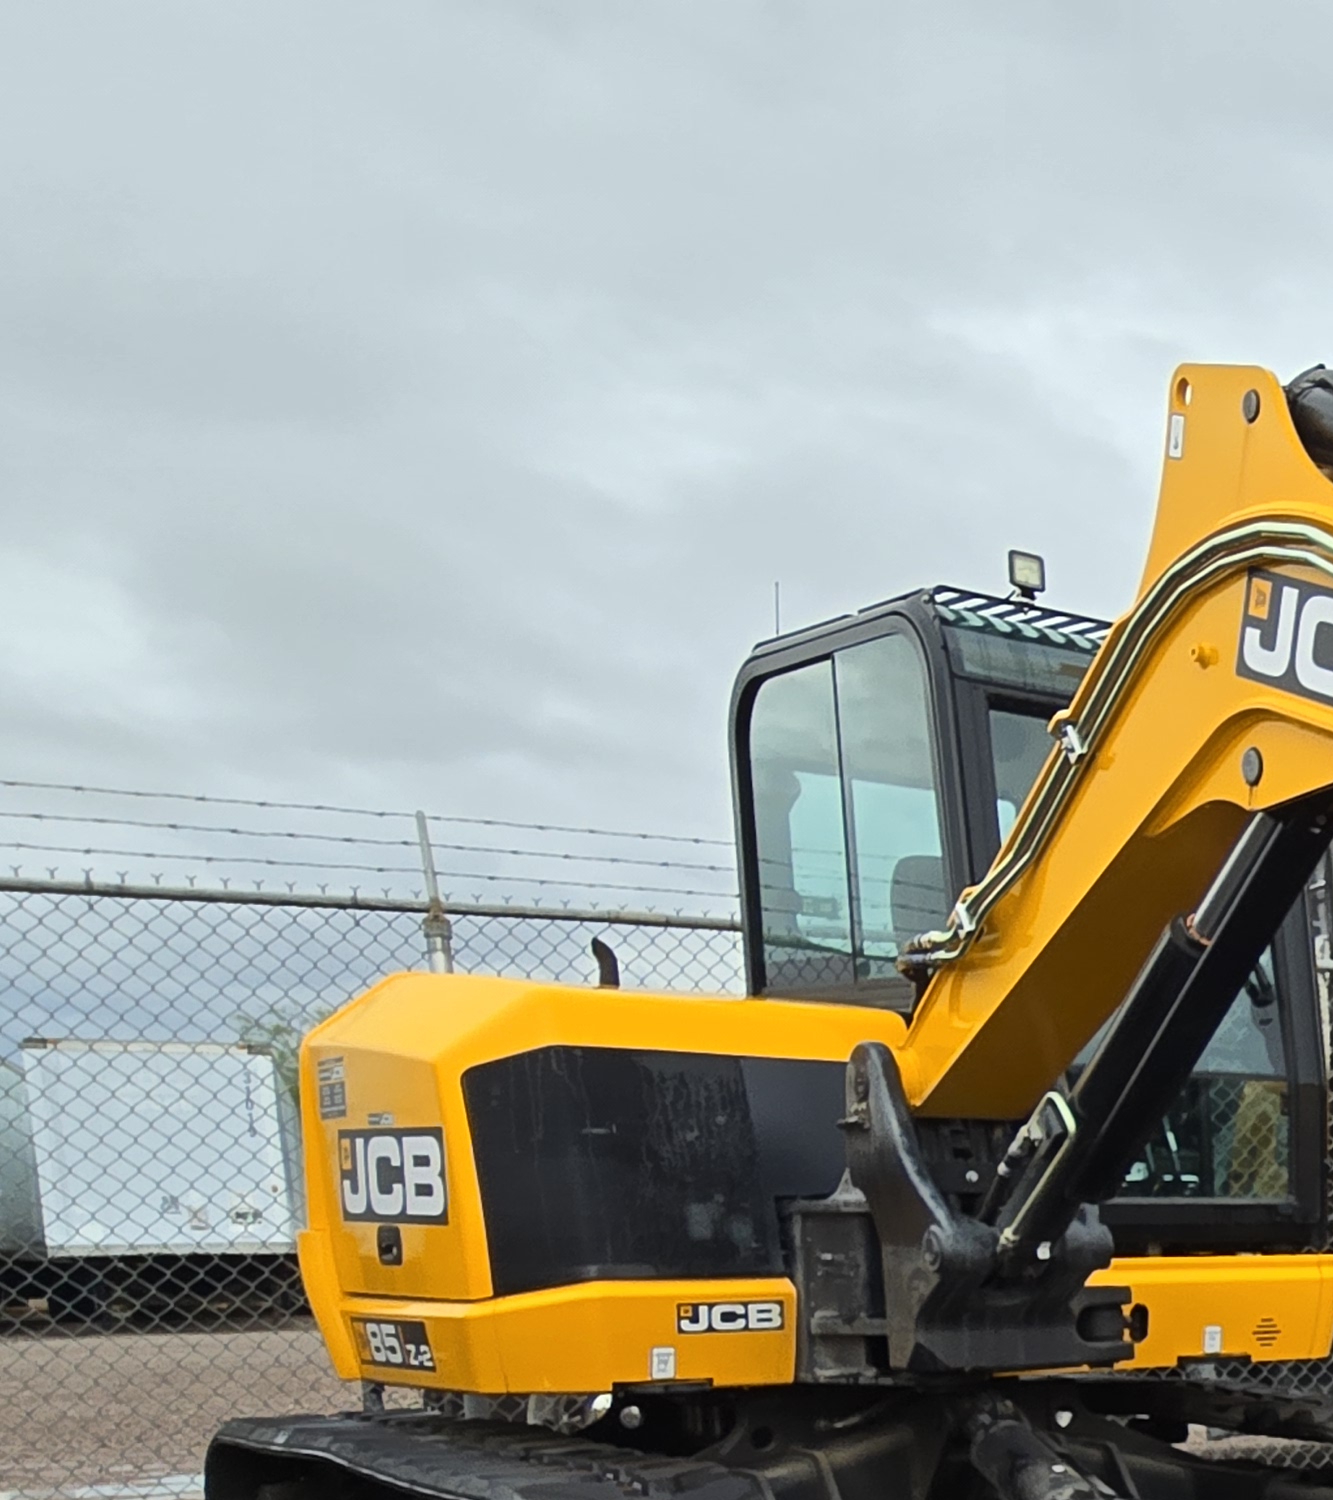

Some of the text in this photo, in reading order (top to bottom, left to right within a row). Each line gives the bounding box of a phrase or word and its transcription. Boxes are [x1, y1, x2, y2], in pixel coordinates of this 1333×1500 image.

[342, 1135, 445, 1216] JCB
[680, 1303, 782, 1332] JCB
[365, 1322, 403, 1364] 85
